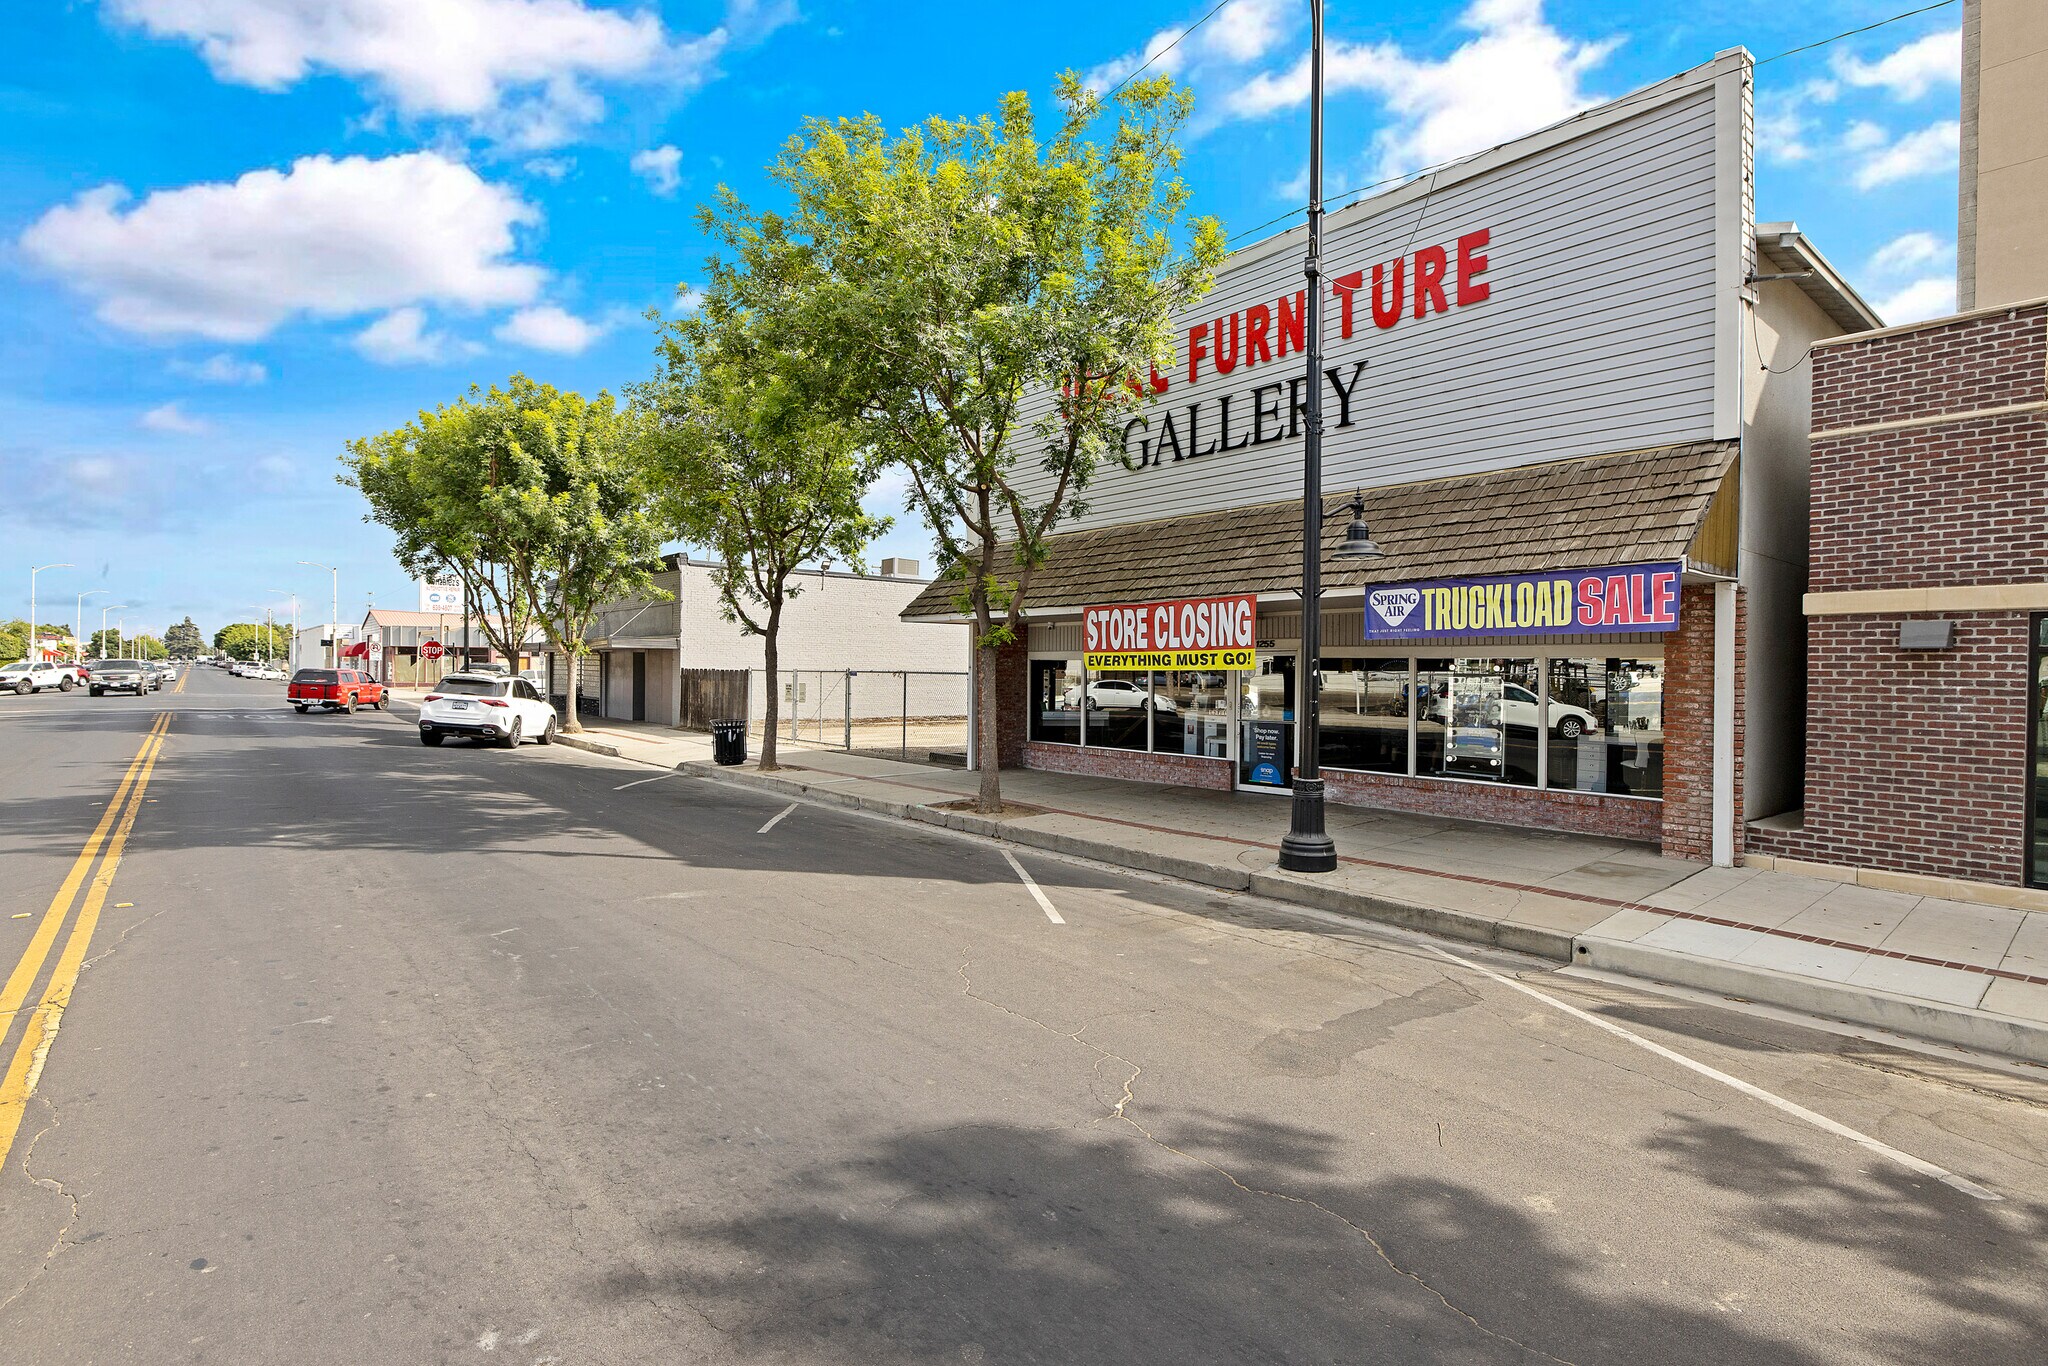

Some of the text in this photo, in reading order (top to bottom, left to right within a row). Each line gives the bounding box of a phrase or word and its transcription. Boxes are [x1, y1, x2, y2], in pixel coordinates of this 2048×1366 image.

[1189, 228, 1490, 383] FURNTURE
[1121, 360, 1369, 471] GALLERY
[1372, 593, 1417, 606] SPRING
[1421, 572, 1676, 631] TRUCKLOAD SALE
[1384, 606, 1405, 617] AIR
[1087, 599, 1252, 650] STORE CLOSING
[423, 646, 443, 655] STOP
[1256, 640, 1275, 648] 1255
[1088, 652, 1251, 667] EVERYTHING MUST GO!
